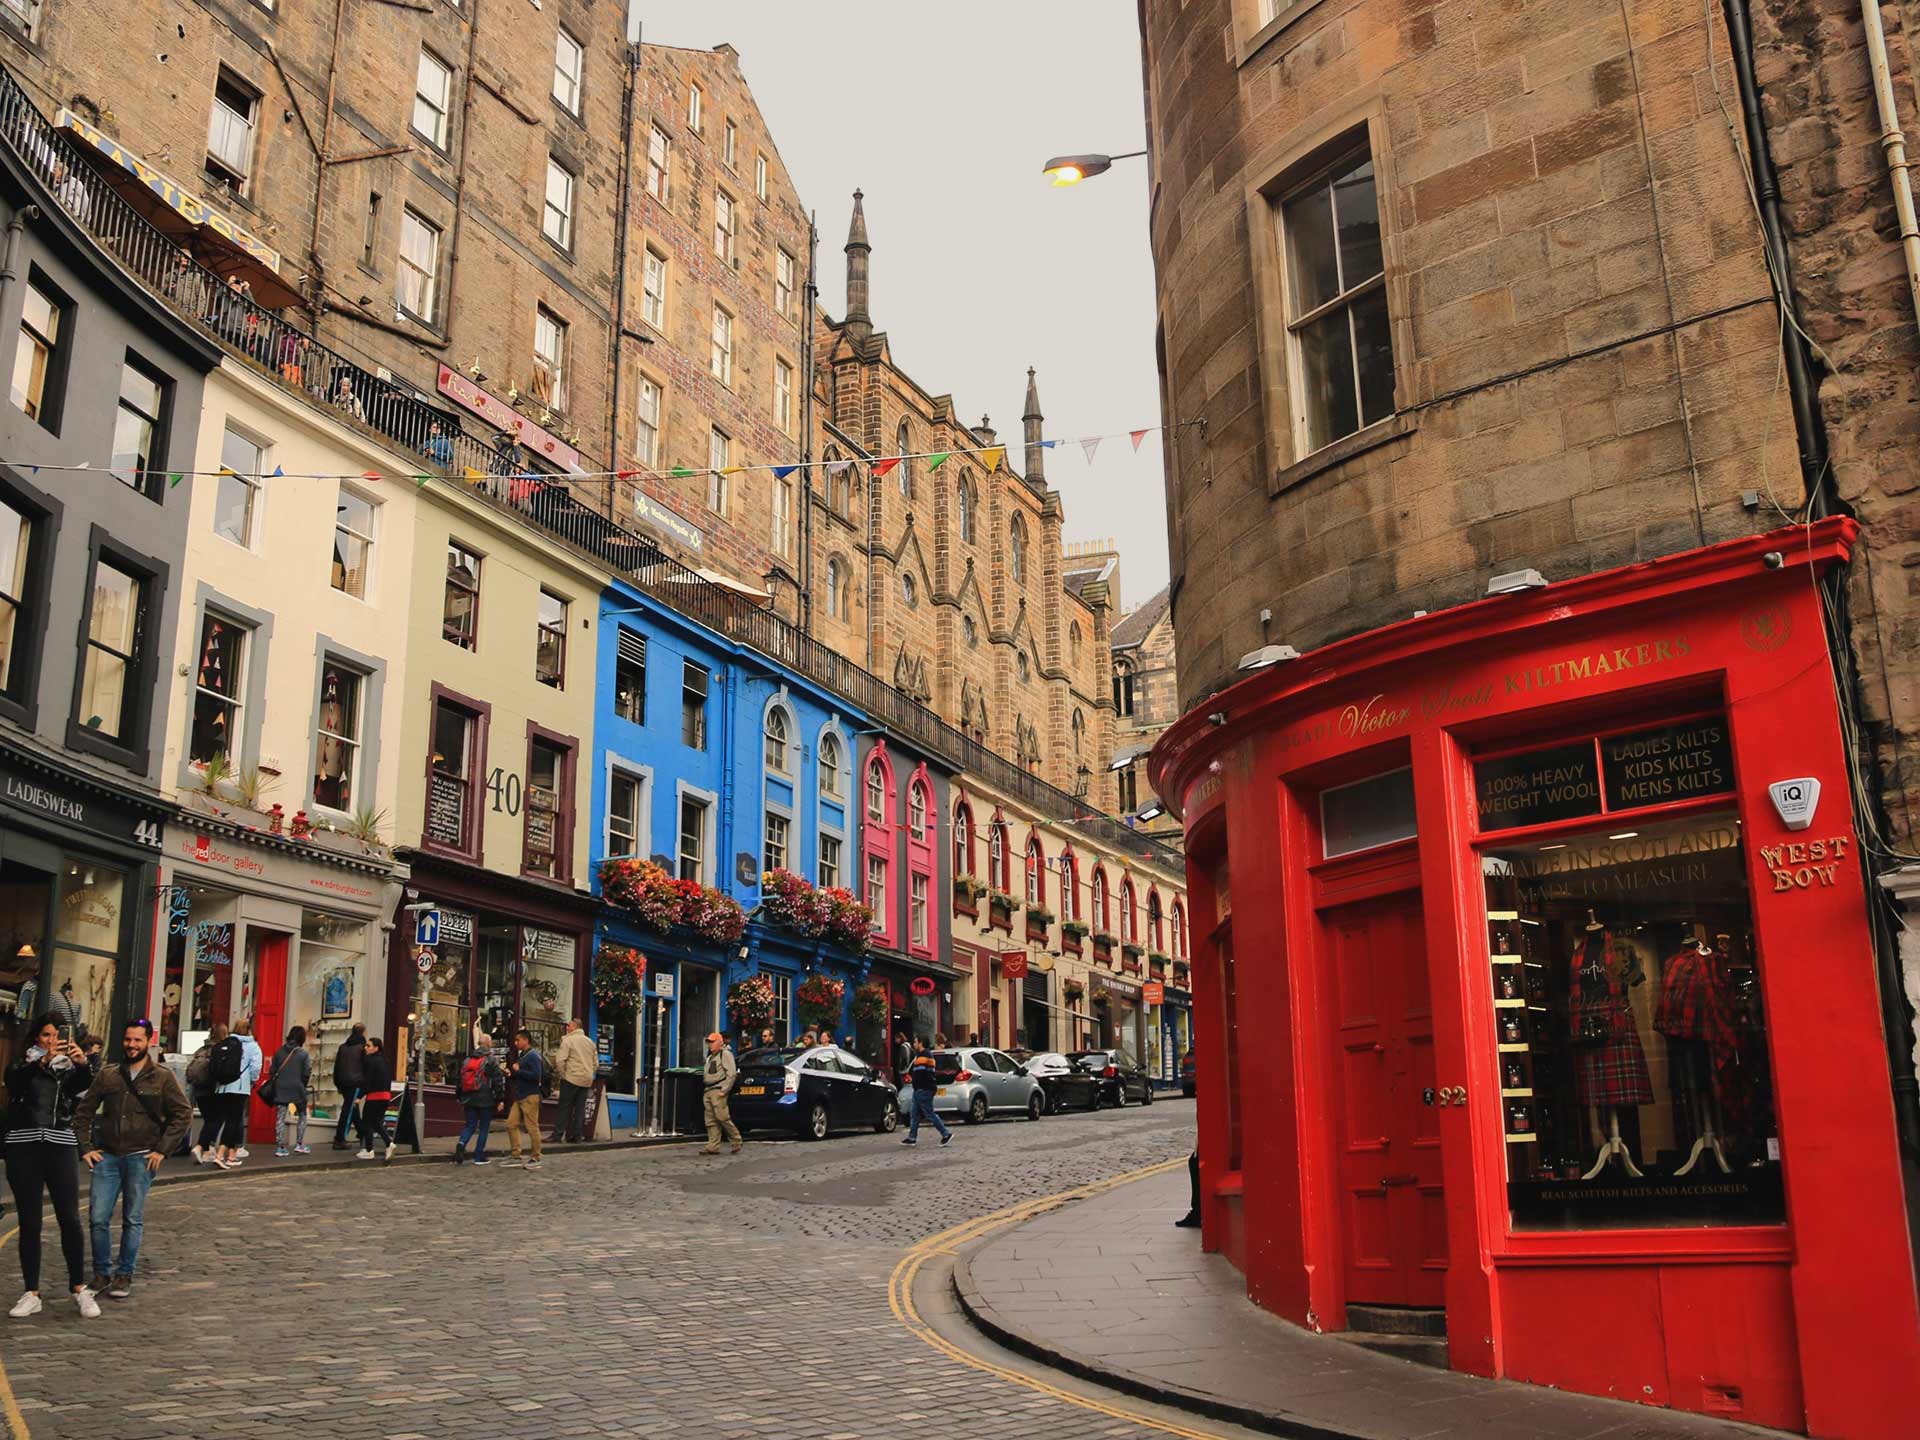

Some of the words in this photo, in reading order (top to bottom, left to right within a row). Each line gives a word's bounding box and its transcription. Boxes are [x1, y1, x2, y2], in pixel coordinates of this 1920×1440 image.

[1505, 634, 1692, 695] KILTMAKERS
[1338, 694, 1410, 738] Victor
[1613, 737, 1671, 761] LADIES
[1676, 727, 1721, 751] KILTS
[1486, 775, 1528, 796] 100%
[1532, 764, 1585, 786] HEAVY
[1624, 759, 1664, 779] KIDS
[1668, 750, 1713, 771] KILTS
[7, 777, 84, 822] LADIESWEAR
[486, 767, 521, 817] 40
[1478, 791, 1540, 816] WEIGHT
[1546, 782, 1598, 804] WOOL
[1621, 780, 1673, 801] MENS
[1677, 768, 1723, 791] KILTS
[1783, 786, 1802, 801] iQ
[182, 840, 197, 855] the
[196, 846, 209, 859] red
[210, 850, 231, 863] door
[233, 856, 264, 875] gallery
[1493, 857, 1562, 882] MADE
[1567, 849, 1592, 872] IN
[1599, 828, 1734, 867] SCOTLAND
[1760, 836, 1849, 870] WEST
[1613, 862, 1714, 890] MEASURE
[1772, 861, 1840, 891] BOW
[419, 957, 431, 967] 20
[1439, 1085, 1467, 1106] 92
[1568, 1187, 1619, 1200] SCOTTISH
[1622, 1185, 1652, 1199] KILTS
[1654, 1185, 1679, 1198] AND
